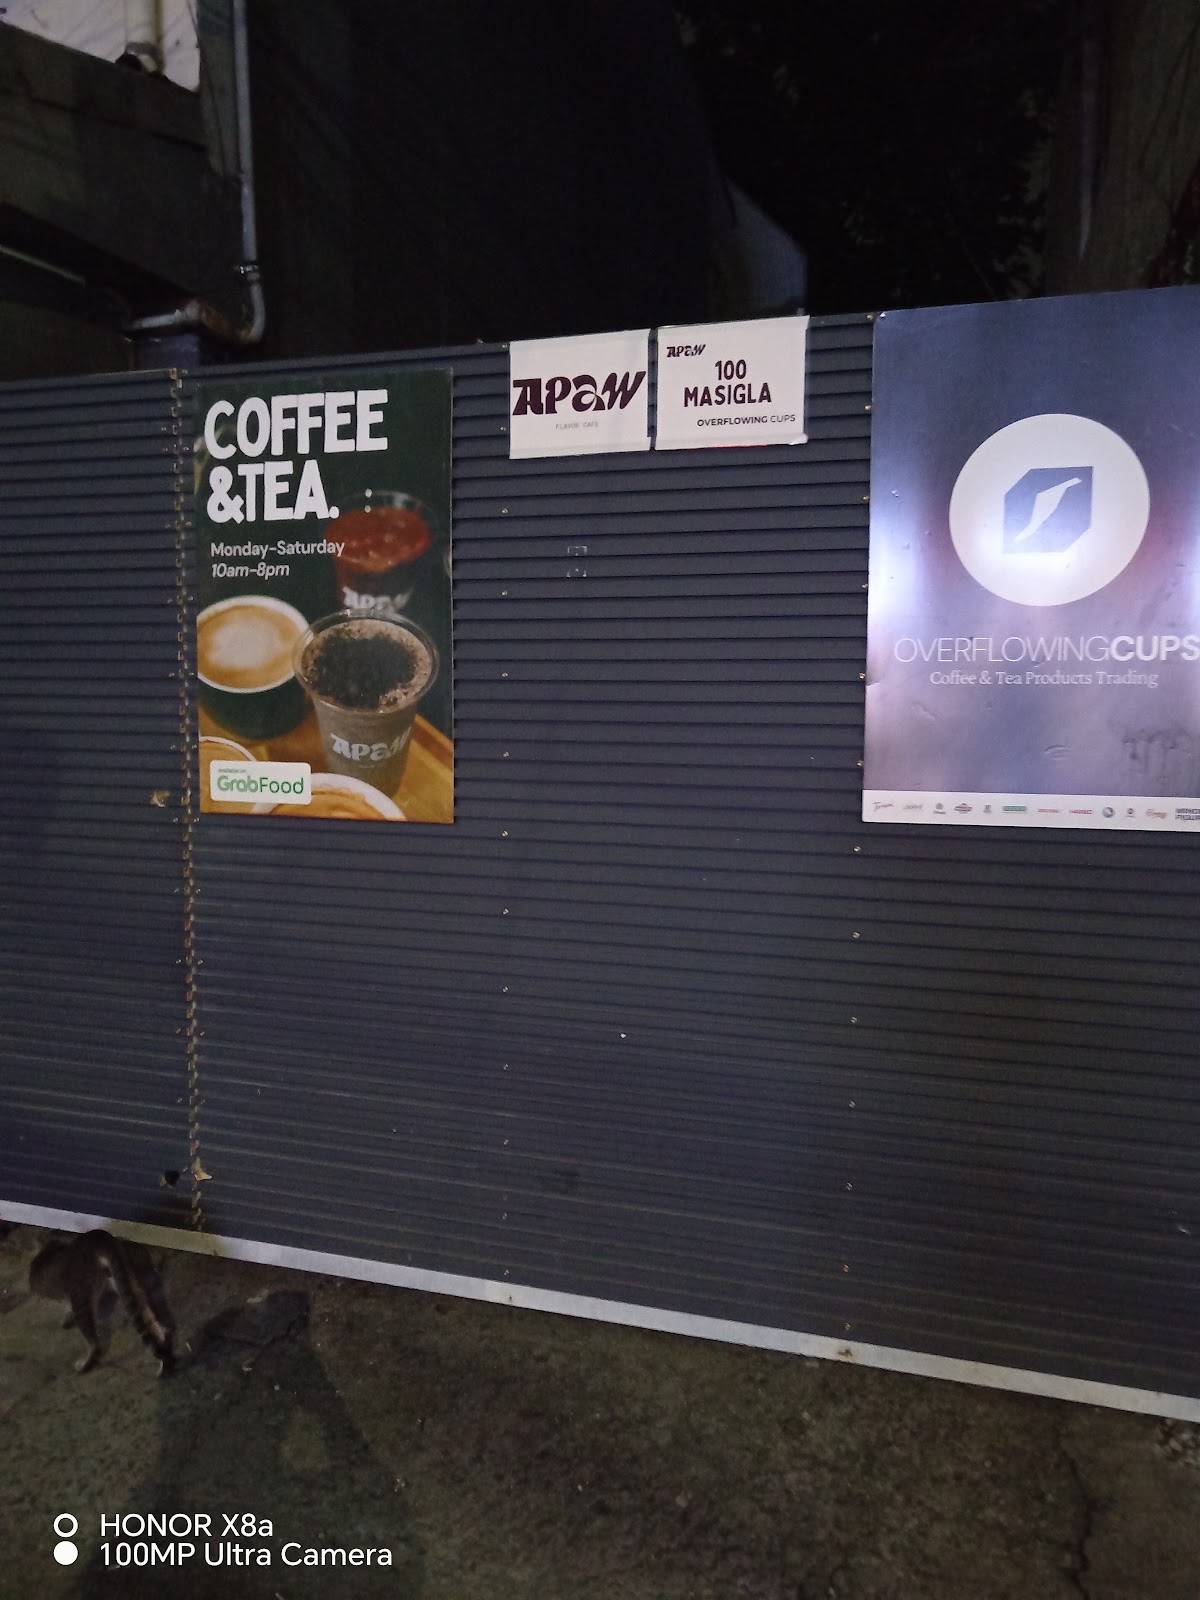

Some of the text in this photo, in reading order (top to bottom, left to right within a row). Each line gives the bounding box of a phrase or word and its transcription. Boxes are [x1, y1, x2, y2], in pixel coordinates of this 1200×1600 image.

[715, 359, 747, 380] 100
[684, 382, 772, 407] MASIGLA
[204, 389, 388, 459] COFFEE
[697, 414, 796, 427] OVERFLOWING CUPS
[206, 459, 340, 523] &TEA.
[211, 563, 290, 580] 10am-8pm
[929, 669, 1160, 688] Coffee & Tea Products Trading
[217, 775, 304, 794] GrabFood
